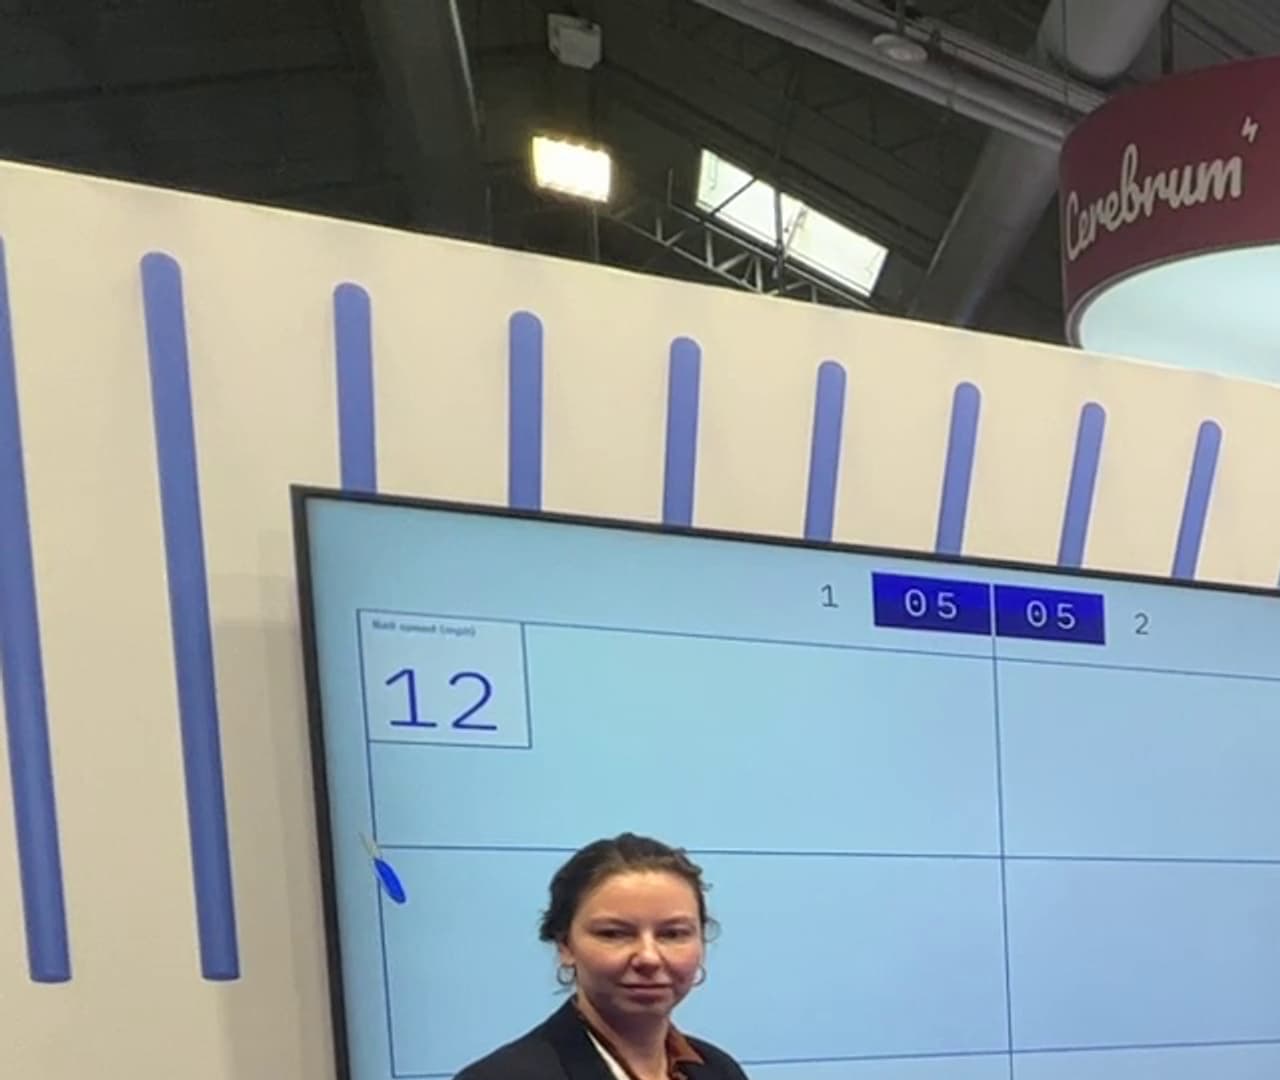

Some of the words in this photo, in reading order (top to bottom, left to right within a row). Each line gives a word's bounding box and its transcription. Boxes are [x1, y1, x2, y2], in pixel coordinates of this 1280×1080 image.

[1066, 143, 1243, 261] Cerebrum
[821, 584, 839, 608] 1
[904, 588, 958, 619] 05
[1026, 600, 1077, 629] 05
[1134, 613, 1149, 635] 2
[385, 669, 498, 731] 12
